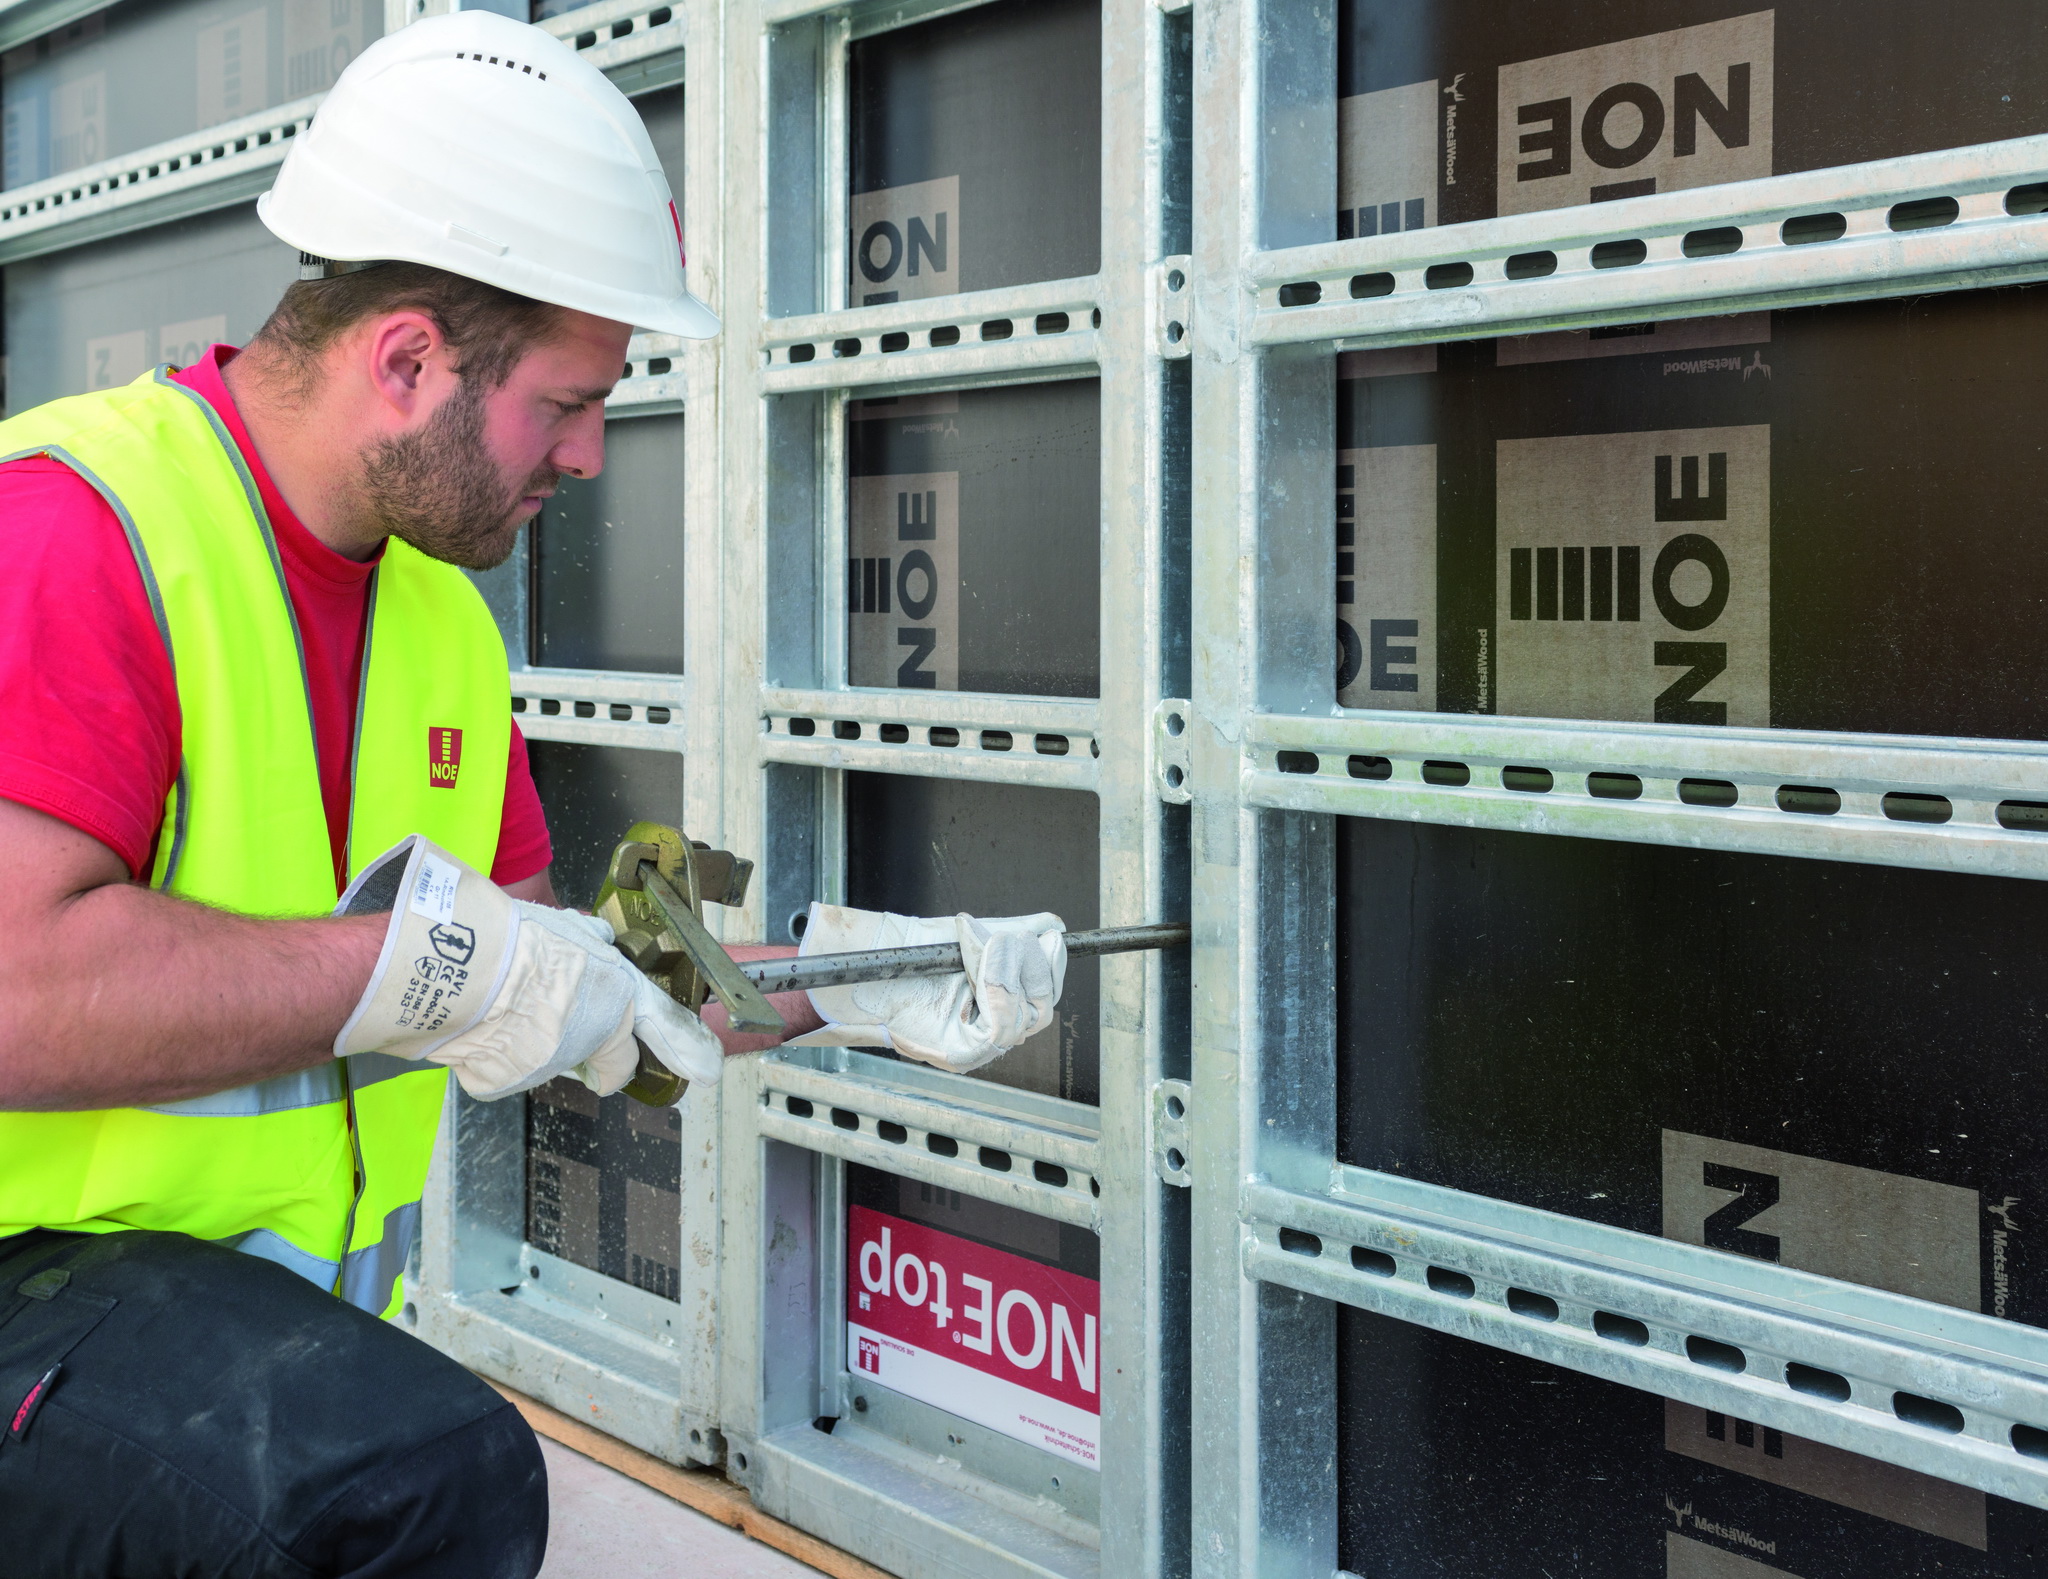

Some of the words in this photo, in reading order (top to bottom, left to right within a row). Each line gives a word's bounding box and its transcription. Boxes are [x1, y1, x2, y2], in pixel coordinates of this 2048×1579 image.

[1517, 62, 1751, 182] NOE
[851, 211, 948, 284] NO
[897, 490, 938, 689] NOE
[1652, 452, 1731, 726] NOE
[431, 762, 458, 781] NOE
[400, 978, 420, 1008] 3133
[419, 983, 430, 996] EN
[447, 969, 468, 998] RVL
[1993, 1229, 2008, 1318] MetsäWoo
[860, 1340, 879, 1356] NOE
